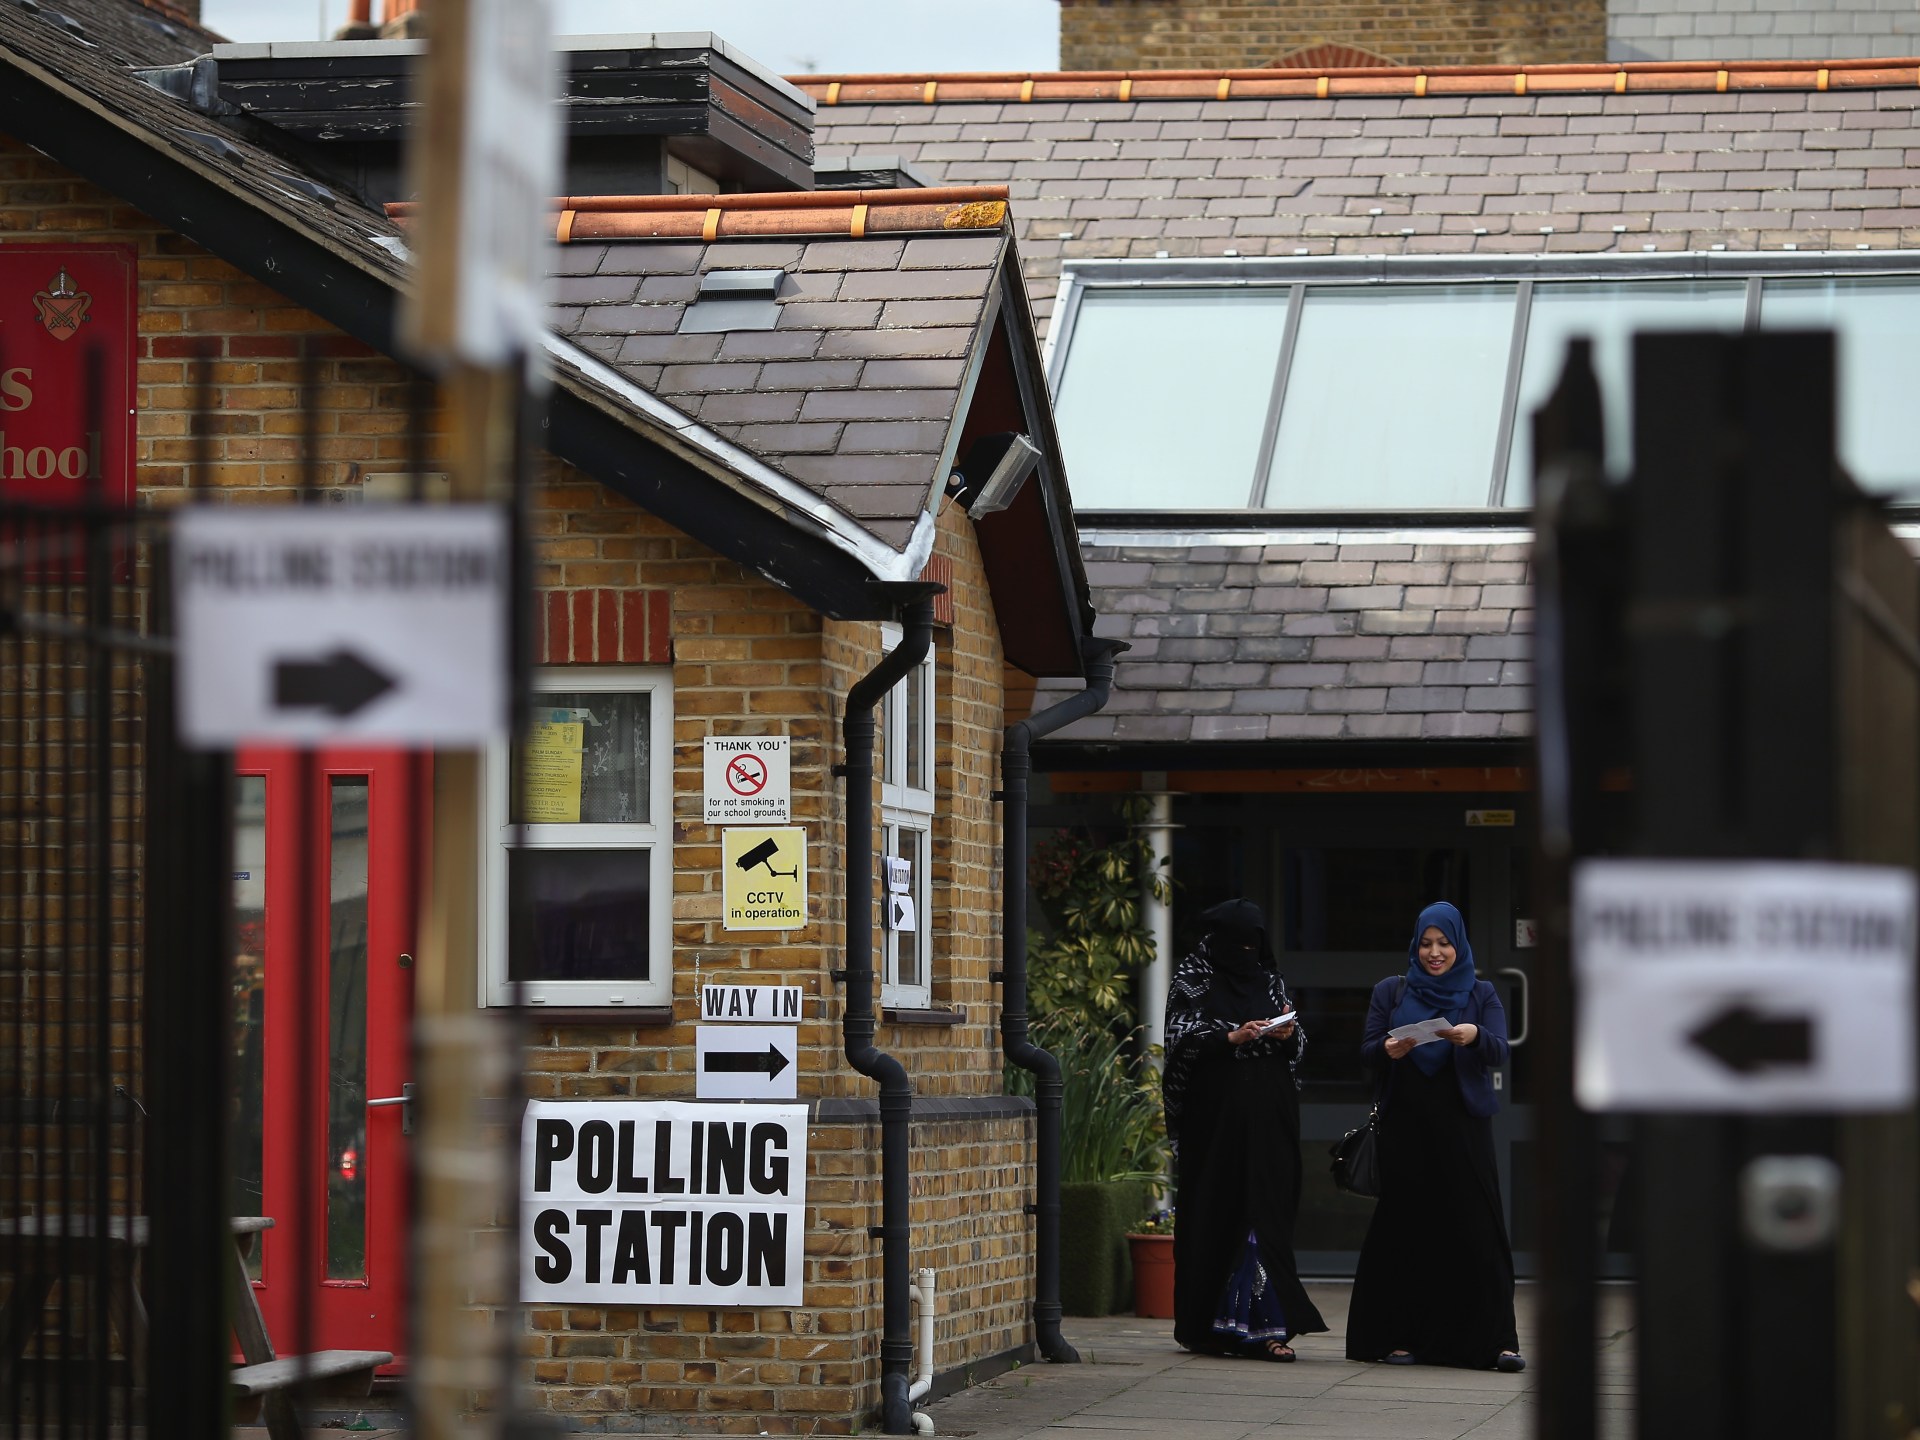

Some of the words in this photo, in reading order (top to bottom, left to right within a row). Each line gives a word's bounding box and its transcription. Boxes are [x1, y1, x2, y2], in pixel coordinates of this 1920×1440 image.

[714, 741, 752, 751] THANK
[757, 741, 780, 751] YOU
[709, 798, 720, 806] for
[724, 798, 737, 806] not
[741, 798, 774, 807] smoking
[778, 798, 785, 806] in
[724, 808, 751, 817] school
[754, 808, 786, 818] grounds
[746, 892, 784, 904] CCTV
[731, 908, 741, 918] in
[745, 907, 800, 920] operation
[705, 988, 758, 1017] WAY
[772, 989, 798, 1017] IN
[534, 1119, 789, 1196] POLLING
[534, 1209, 788, 1287] STATION
